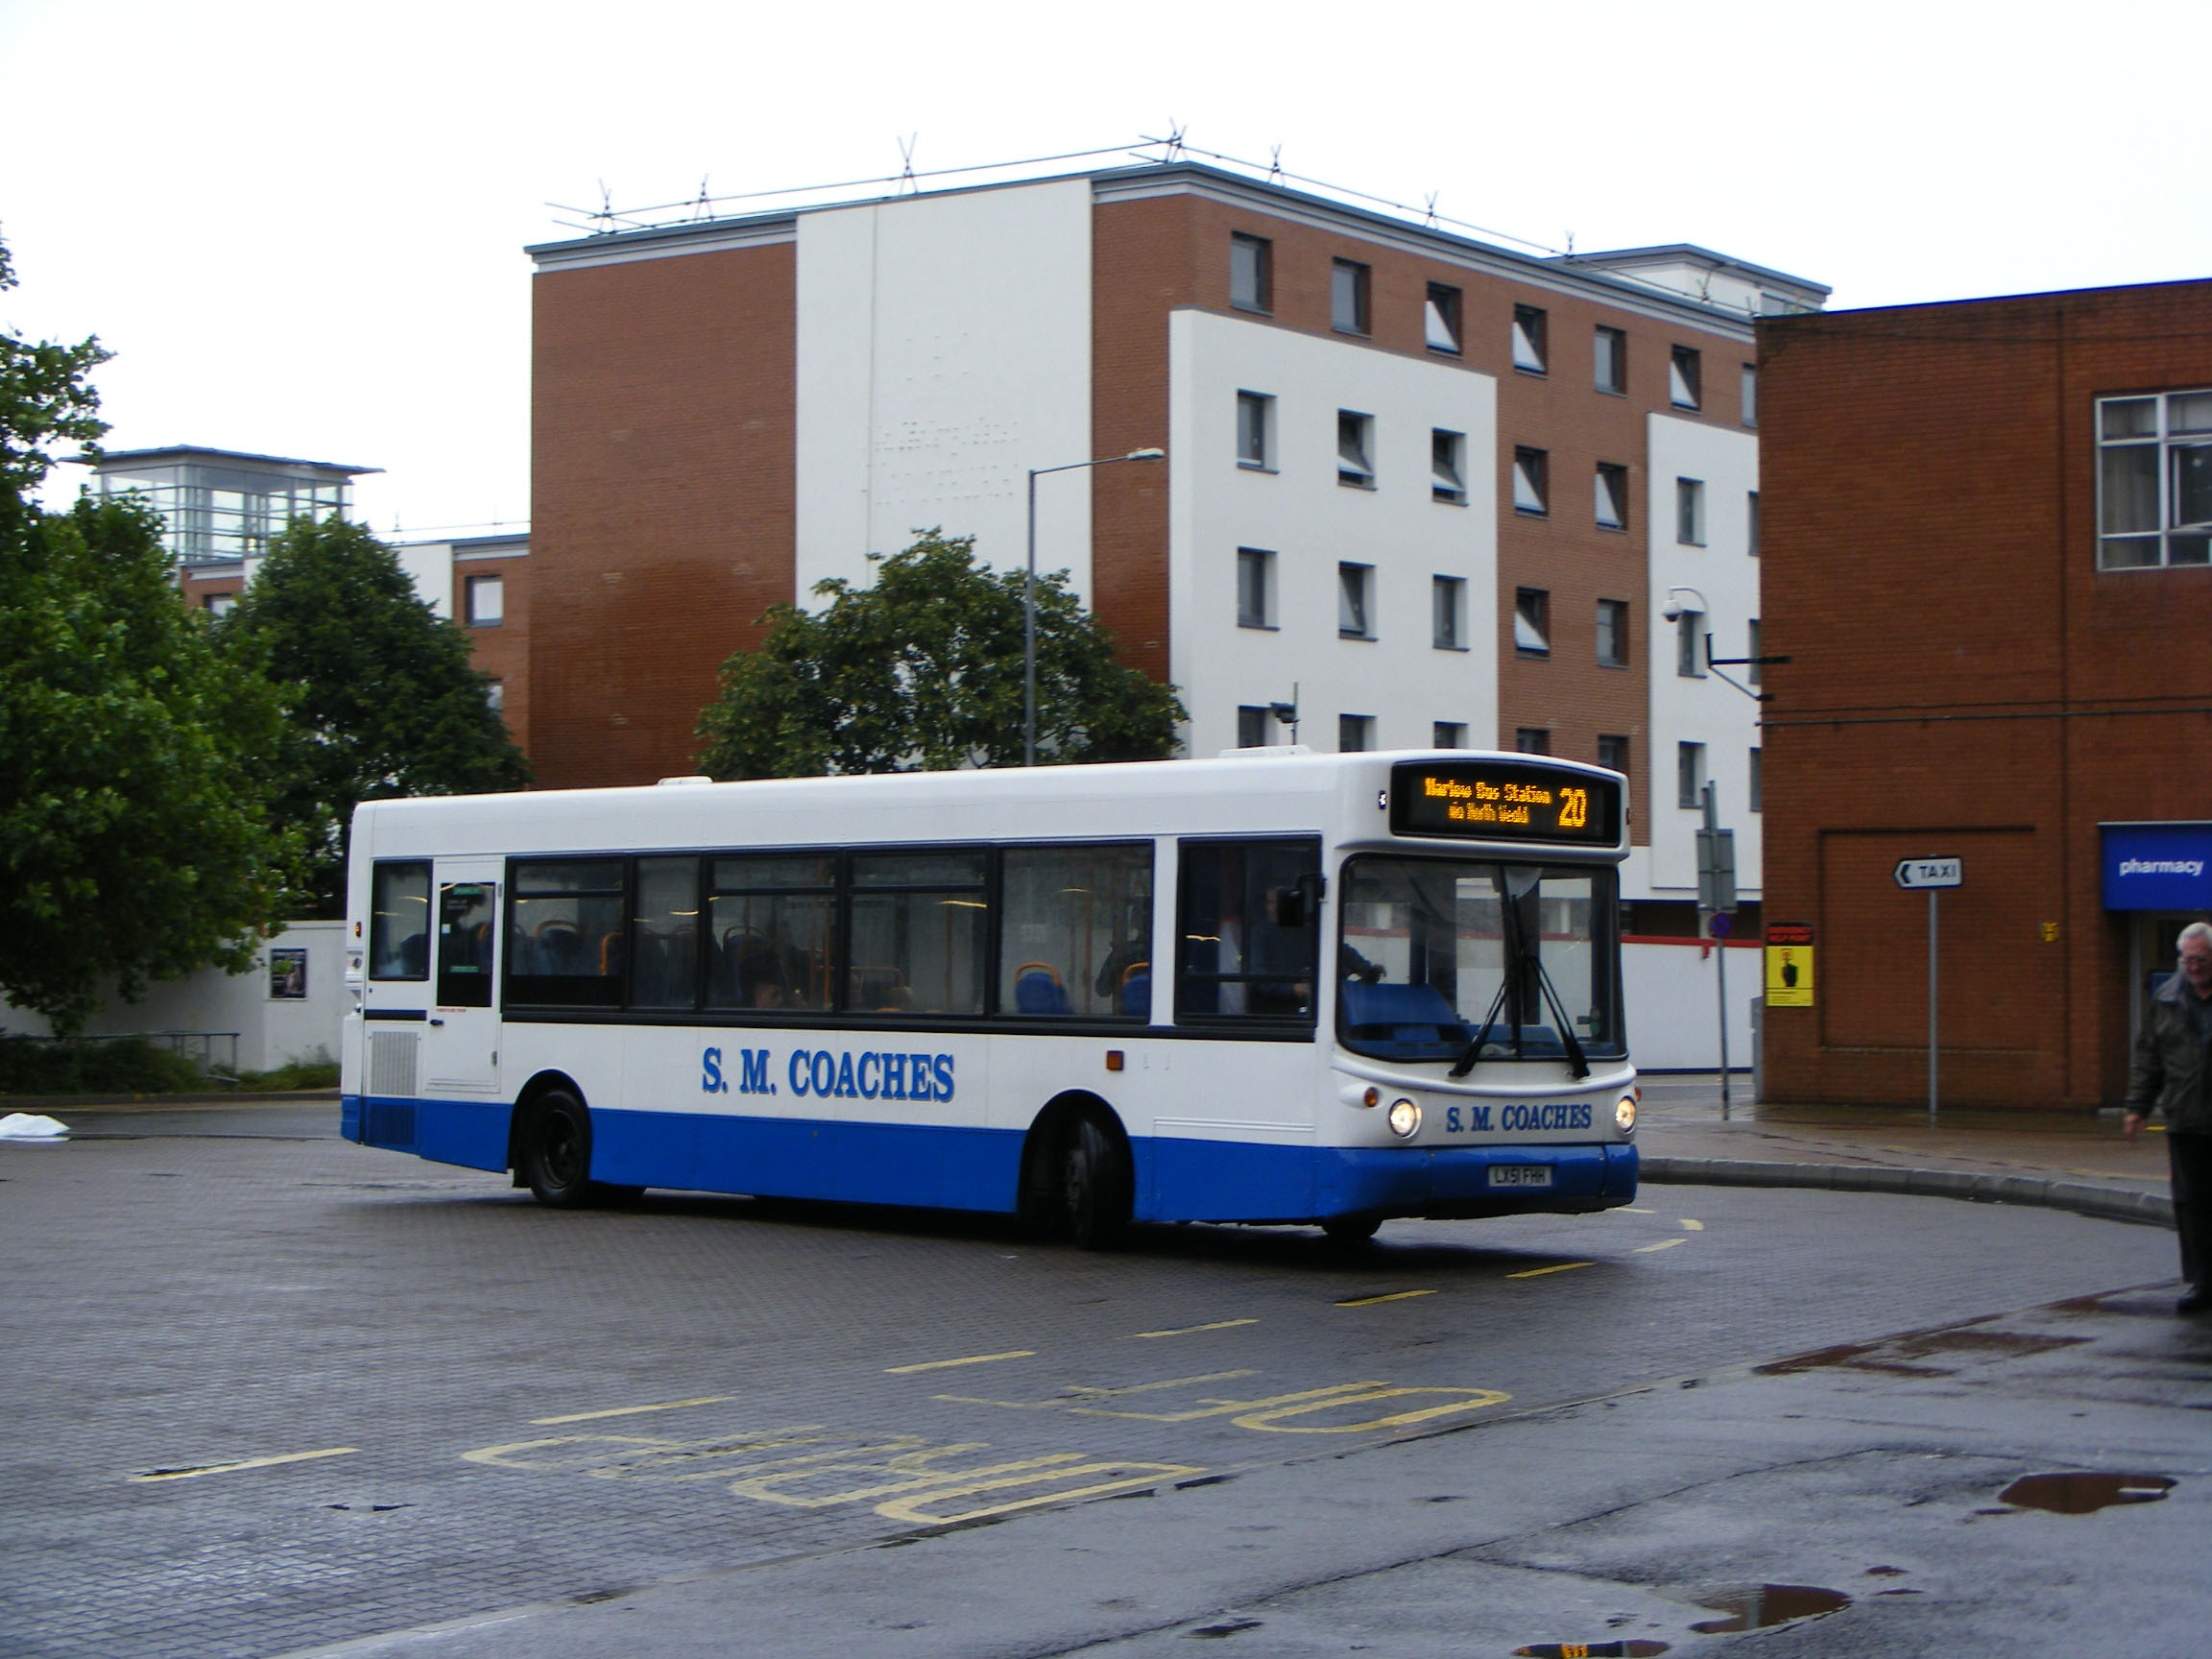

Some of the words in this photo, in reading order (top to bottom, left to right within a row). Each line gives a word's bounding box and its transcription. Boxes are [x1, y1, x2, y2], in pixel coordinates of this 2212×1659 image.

[1475, 781, 1500, 800] Bus
[1503, 783, 1552, 805] Station
[1558, 787, 1587, 827] 20
[1918, 865, 1956, 878] TAXI
[2119, 858, 2204, 876] pharmacy
[702, 1046, 728, 1094] S.
[740, 1048, 777, 1095] M.
[789, 1049, 955, 1103] COACHES
[1447, 1107, 1464, 1133] S.
[1472, 1106, 1494, 1132] M.
[1502, 1104, 1592, 1131] COACHES
[928, 1368, 1513, 1433] OFF
[462, 1425, 1209, 1527] DROP
